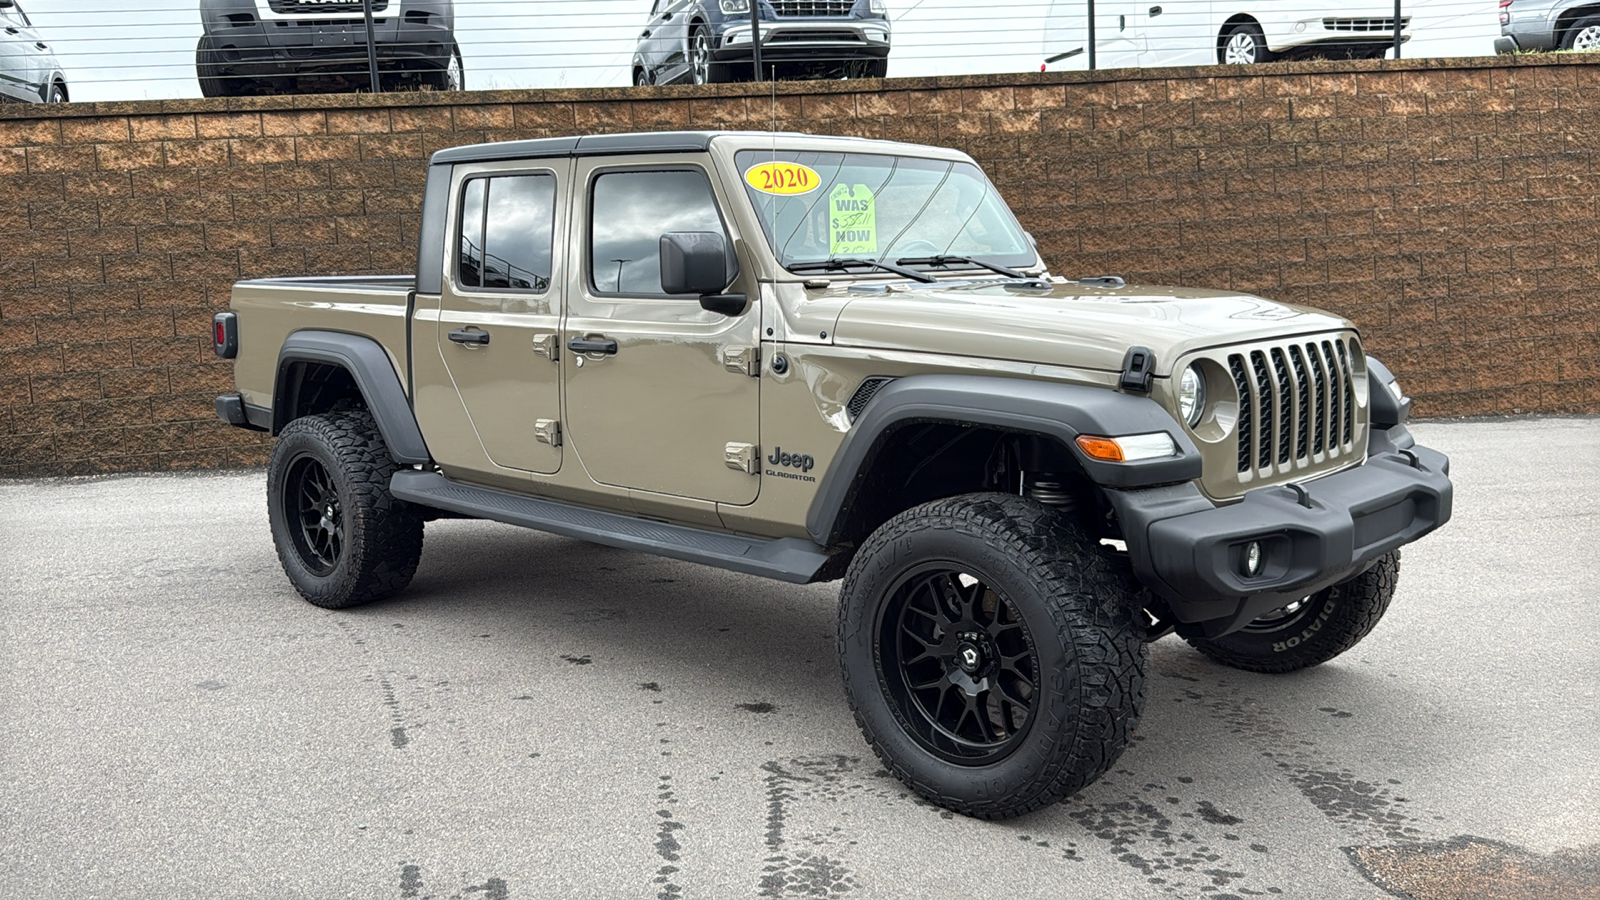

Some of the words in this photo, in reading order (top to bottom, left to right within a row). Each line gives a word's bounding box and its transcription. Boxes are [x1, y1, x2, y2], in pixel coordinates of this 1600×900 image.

[760, 168, 808, 189] 2020
[836, 199, 869, 211] WAS
[836, 230, 870, 242] NOW
[768, 446, 814, 473] Jeep
[765, 469, 816, 482] GLADIATOR
[1272, 585, 1340, 653] ADIATOR
